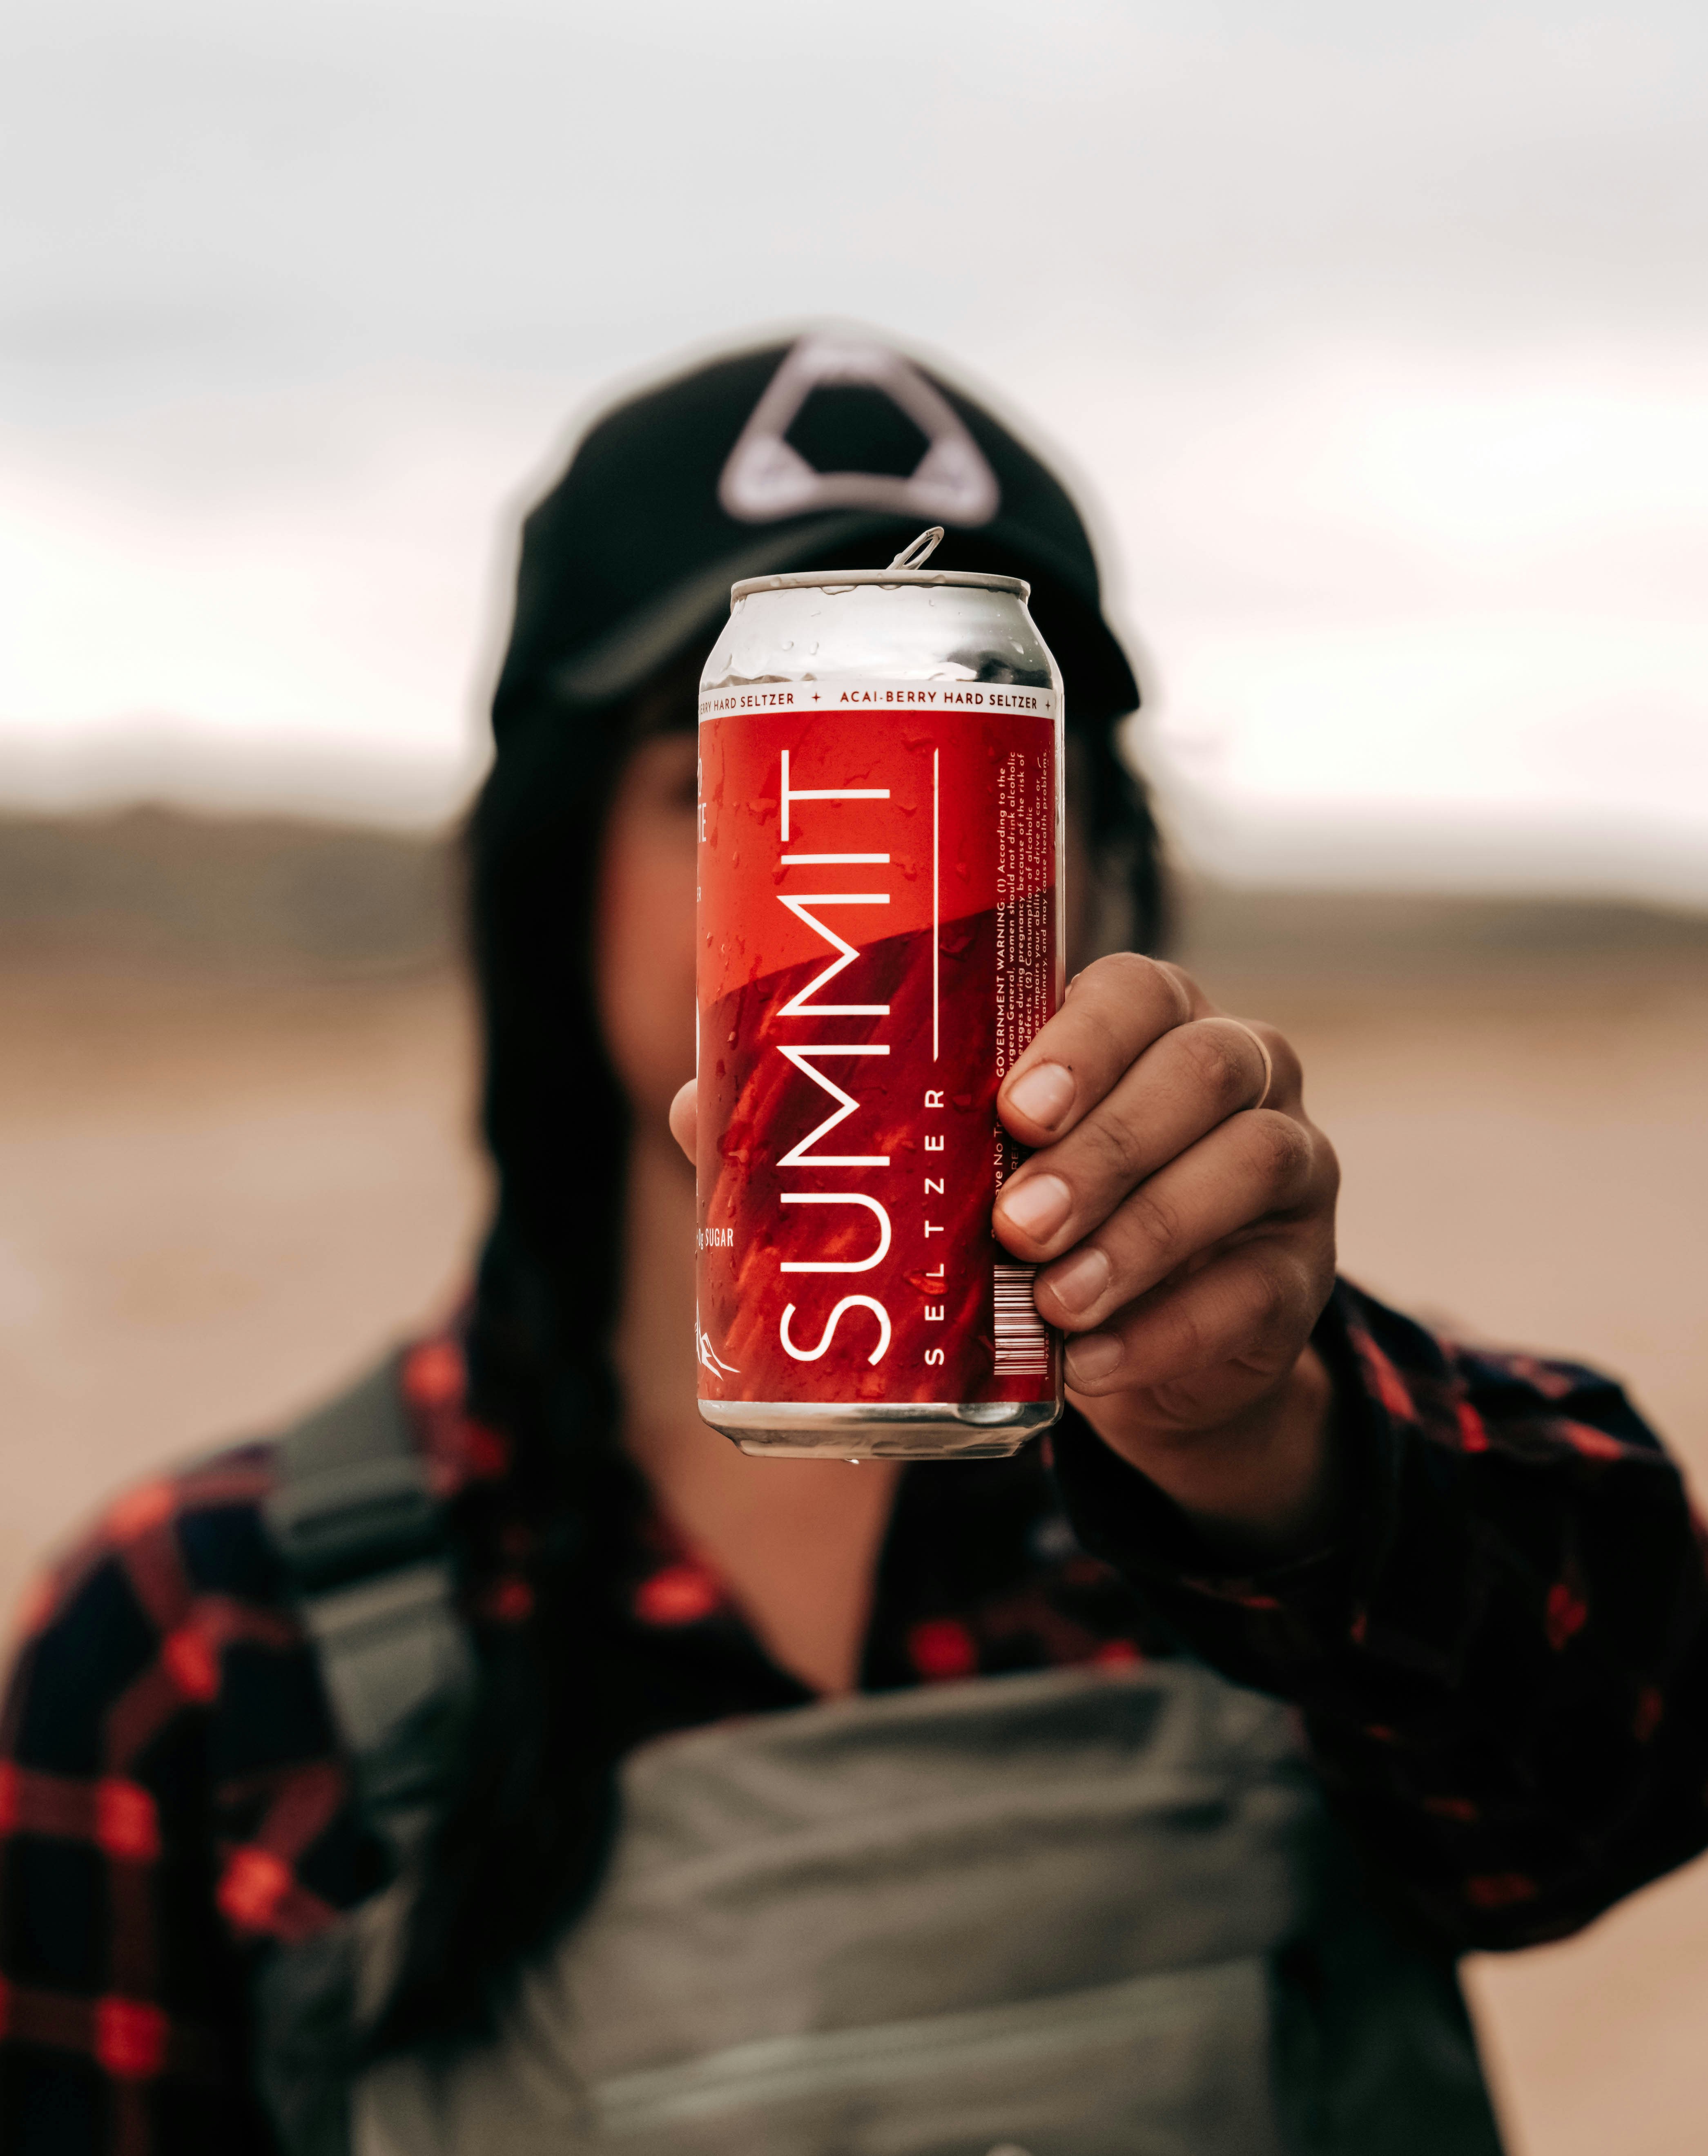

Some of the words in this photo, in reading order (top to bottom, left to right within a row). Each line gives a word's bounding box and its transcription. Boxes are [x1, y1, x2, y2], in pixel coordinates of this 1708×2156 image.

[714, 698, 736, 711] HARD
[740, 693, 794, 707] SELTZER
[840, 691, 937, 702] ACAI-BERRY
[944, 692, 983, 705] HARD
[989, 695, 1037, 710] SELTZER
[1017, 753, 1024, 766] of
[997, 768, 1006, 787] the
[1007, 752, 1015, 807] alcoholic
[1036, 779, 1040, 791] or
[998, 792, 1006, 804] to
[1007, 812, 1015, 844] drink
[1017, 822, 1024, 835] of
[997, 810, 1006, 874] According
[1016, 840, 1024, 891] because
[1025, 866, 1032, 879] of
[1035, 869, 1040, 881] to
[997, 878, 1006, 893] (1)
[1007, 874, 1015, 914] should
[997, 898, 1005, 970] WARNING:
[1025, 884, 1033, 966] Consumption
[1016, 968, 1025, 1008] during
[1025, 971, 1033, 989] (2)
[1006, 968, 1015, 1020] General,
[996, 975, 1005, 1078] GOVERNMENT
[776, 750, 892, 1366] SUMMIT
[1007, 1025, 1016, 1068] urgeon
[994, 1143, 1003, 1165] No
[705, 1228, 734, 1247] SUGAR
[925, 1089, 944, 1366] SELTZER
